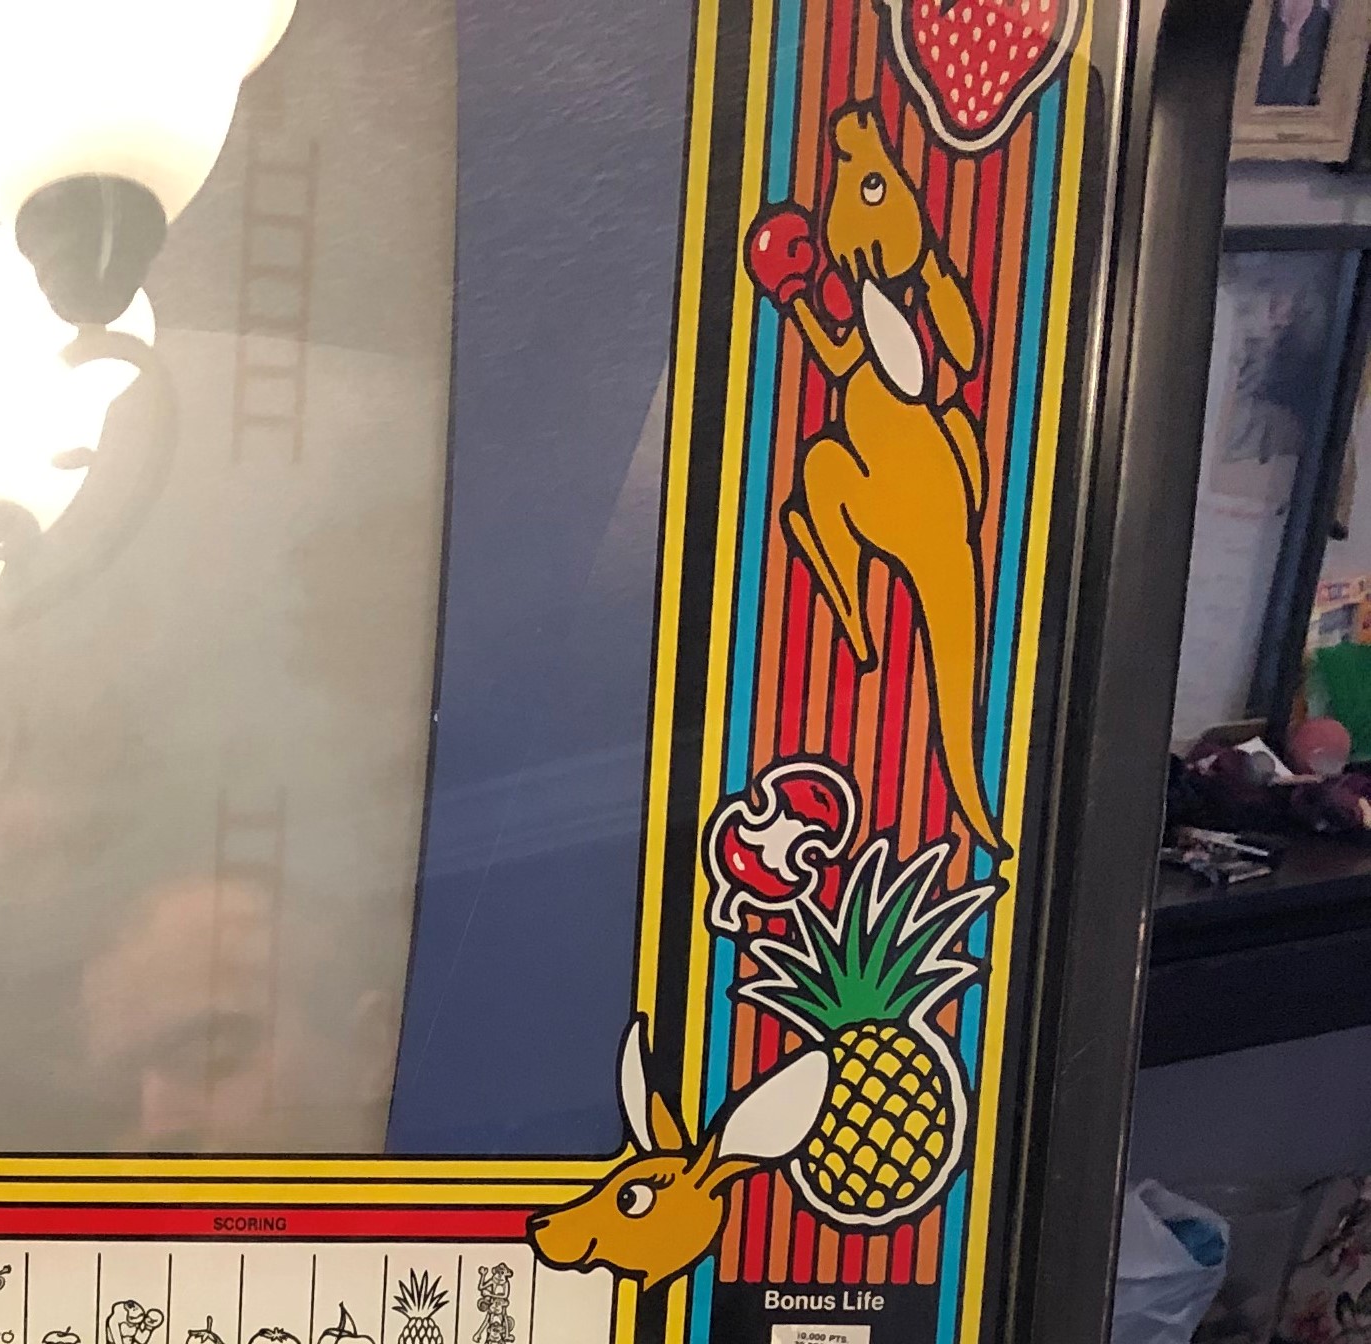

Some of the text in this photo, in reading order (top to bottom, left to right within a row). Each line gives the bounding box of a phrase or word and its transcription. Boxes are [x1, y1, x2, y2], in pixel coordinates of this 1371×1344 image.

[213, 1217, 287, 1231] SCORING
[764, 1290, 884, 1310] Bonus Life
